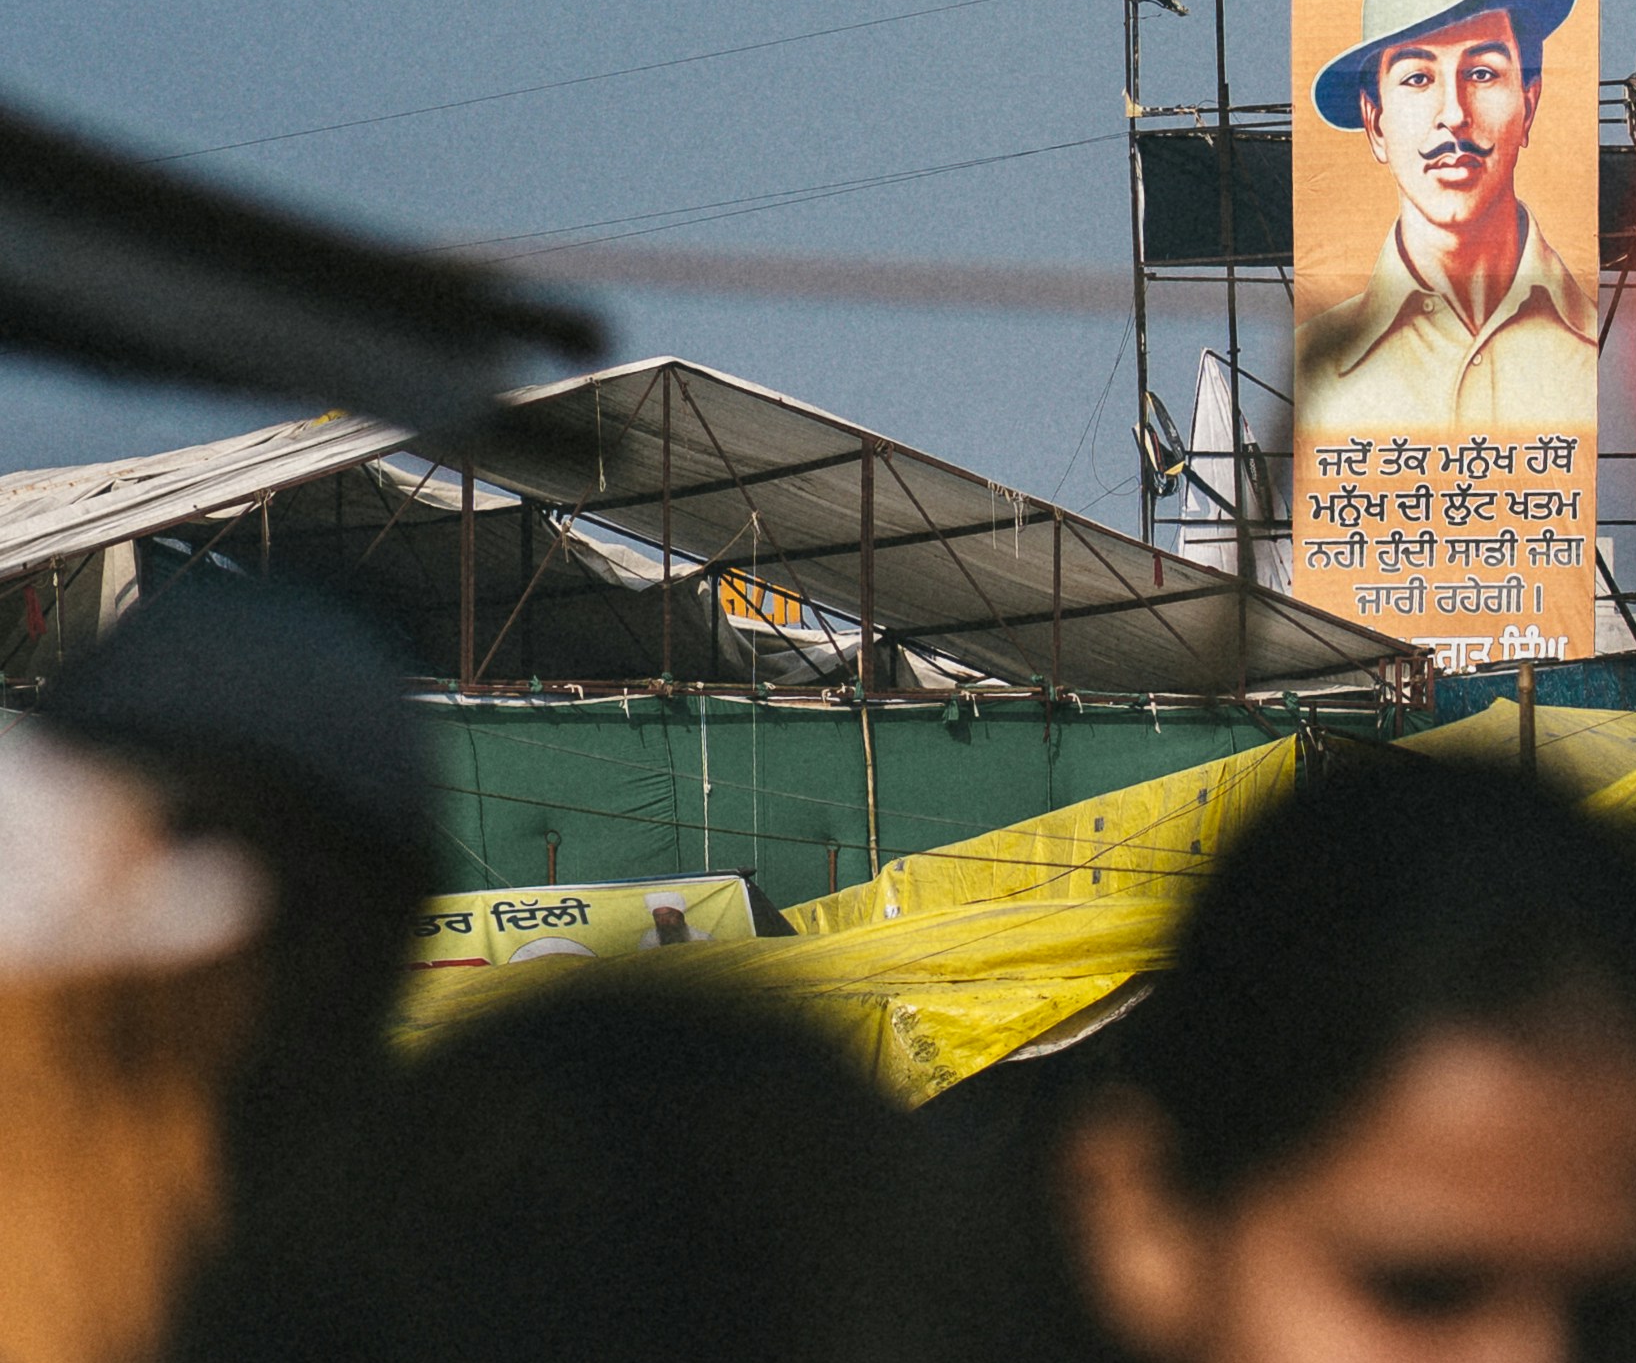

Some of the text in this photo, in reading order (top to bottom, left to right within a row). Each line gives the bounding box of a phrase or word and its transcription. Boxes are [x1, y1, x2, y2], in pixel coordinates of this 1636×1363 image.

[1315, 438, 1373, 476] ਜਦੋਂ
[1378, 438, 1431, 475] ਤੱਕ
[1438, 437, 1517, 479] ਮਨੁੱਖ
[1309, 483, 1581, 527] ਮਨੁੱਖ ਦੀ ਲੁੱਟ ਖਤਮ
[1375, 530, 1438, 573] ਹੁੰਦੀ
[1445, 529, 1519, 567] ਸਾਡੀ
[1525, 529, 1584, 567] ਜੰਗ
[1354, 575, 1427, 615] ਜਾਰੀ
[1433, 576, 1525, 615] ਰਹੇਗੀ
[490, 897, 591, 932] ਦਿੱਲੀ
